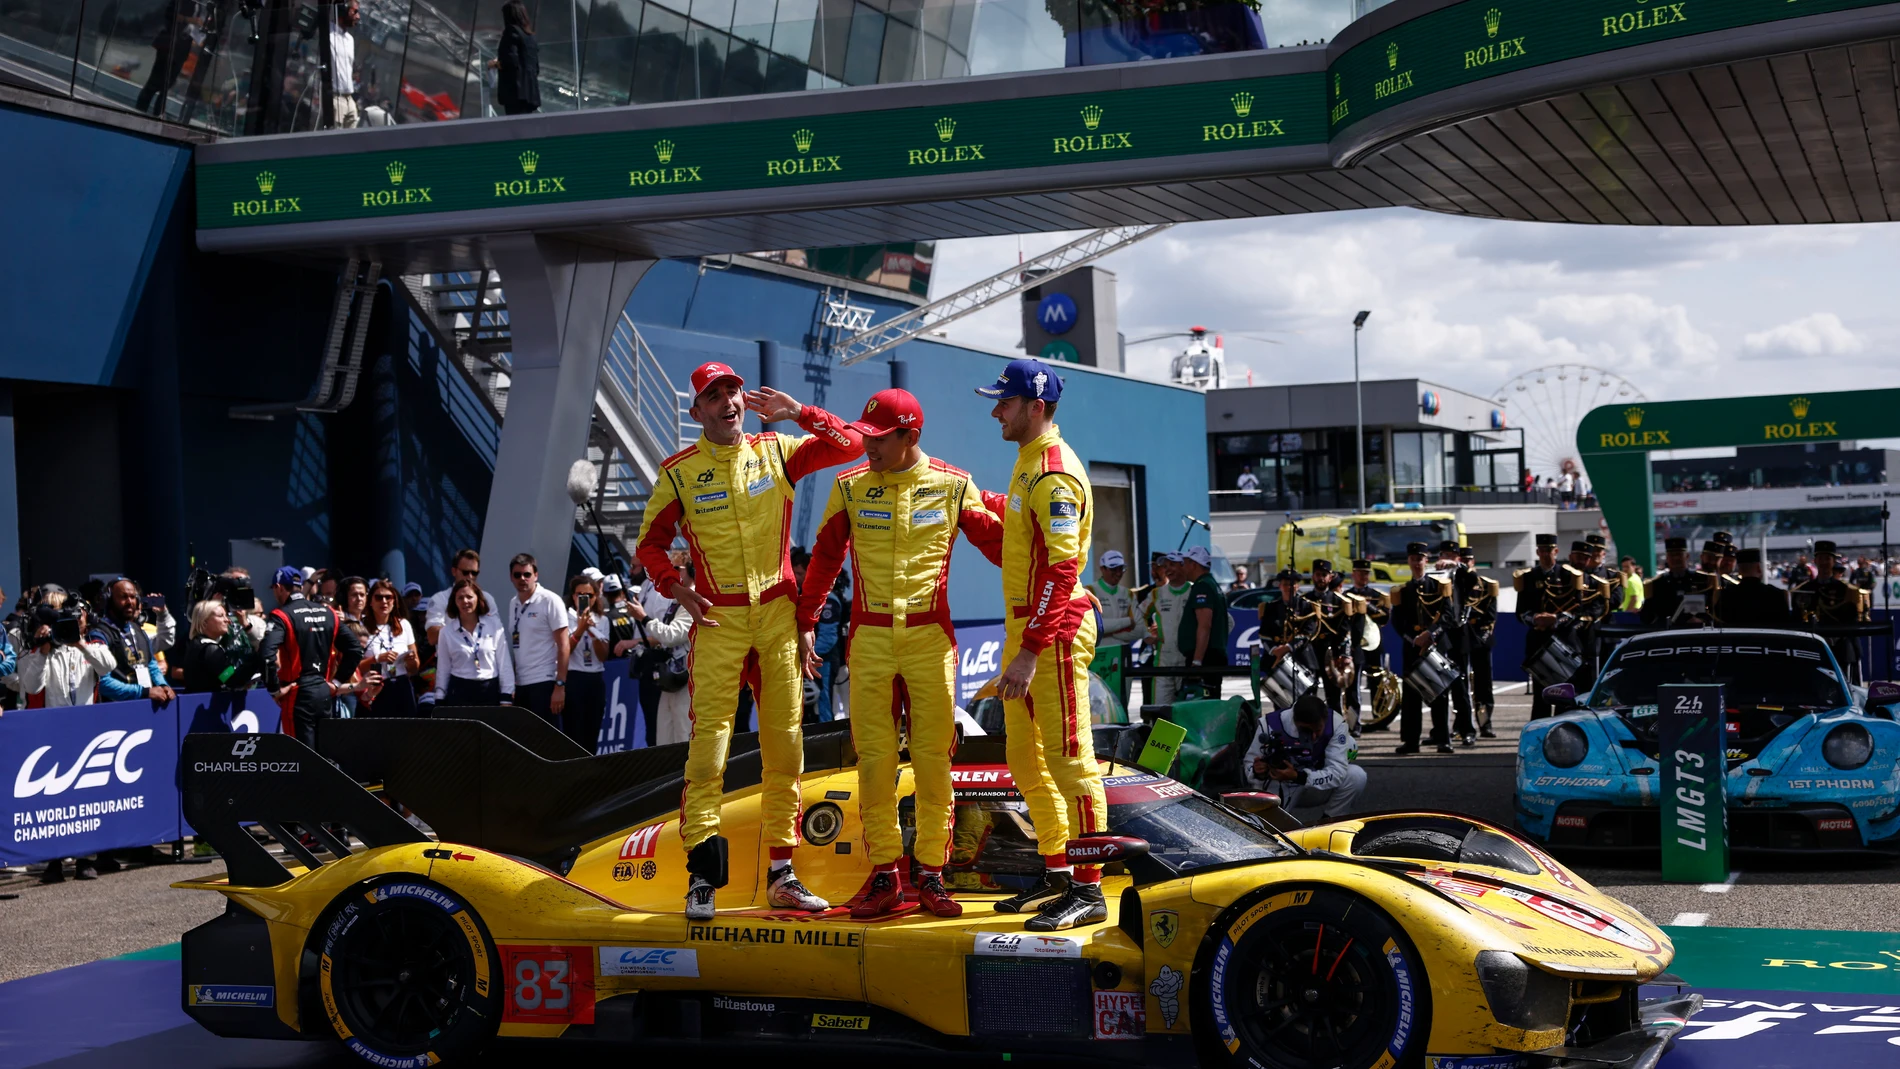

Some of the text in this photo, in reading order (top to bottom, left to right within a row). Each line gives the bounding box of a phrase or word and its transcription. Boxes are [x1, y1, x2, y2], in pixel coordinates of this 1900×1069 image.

[1602, 2, 1688, 37] ROLEX
[1464, 37, 1527, 70] ROLEX
[1375, 70, 1414, 100] ROLEX
[1203, 119, 1286, 141] ROLEX
[1053, 132, 1133, 154] ROLEX
[908, 143, 986, 165] ROLEX
[767, 155, 843, 176] ROLEX
[629, 166, 703, 186] ROLEX
[494, 176, 567, 197] ROLEX
[232, 197, 302, 217] ROLEX
[362, 187, 433, 207] ROLEX
[1600, 430, 1671, 448] ROLEX
[1764, 421, 1839, 440] ROLEX
[1652, 499, 1698, 509] SCHE
[1037, 580, 1055, 617] ORLEN
[961, 641, 1000, 677] WEC
[1620, 646, 1821, 661] PORSCHE
[1674, 695, 1703, 710] 24h
[1150, 740, 1172, 753] SAFE
[14, 729, 153, 799] WEC
[194, 761, 300, 773] CHARLES POZZI
[950, 771, 1000, 782] RLEN
[1533, 776, 1612, 787] 1ST PHORM
[1788, 779, 1875, 789] 1ST PHORM
[1674, 749, 1707, 851] LMGT3
[14, 796, 145, 827] FIA WORLD ENDURANCE
[14, 818, 102, 843] CHAMPIONSHIP
[1556, 817, 1586, 827] MOTUL
[1819, 820, 1853, 830] MOTUL
[621, 822, 666, 857] HY
[1068, 847, 1101, 858] ORLEN
[388, 883, 455, 911] MICHELIN
[1293, 891, 1308, 904] M
[1232, 901, 1274, 936] PILOT SPORT
[459, 915, 484, 959] PILOT SPORT
[691, 925, 860, 948] RICHARD MILLE
[619, 949, 678, 965] WEC
[1521, 942, 1623, 959] RICHARD MILLE
[321, 959, 331, 973] M
[1761, 958, 1900, 971] RO
[477, 978, 487, 992] M
[515, 959, 570, 1011] 83
[1212, 944, 1230, 1025] MICHELIN
[216, 991, 268, 1001] MICHELIN
[713, 996, 776, 1012] Britestone
[1395, 968, 1413, 1051] MICHELIN
[817, 1014, 866, 1029] Sabelt
[350, 1041, 415, 1069] MICHELIN
